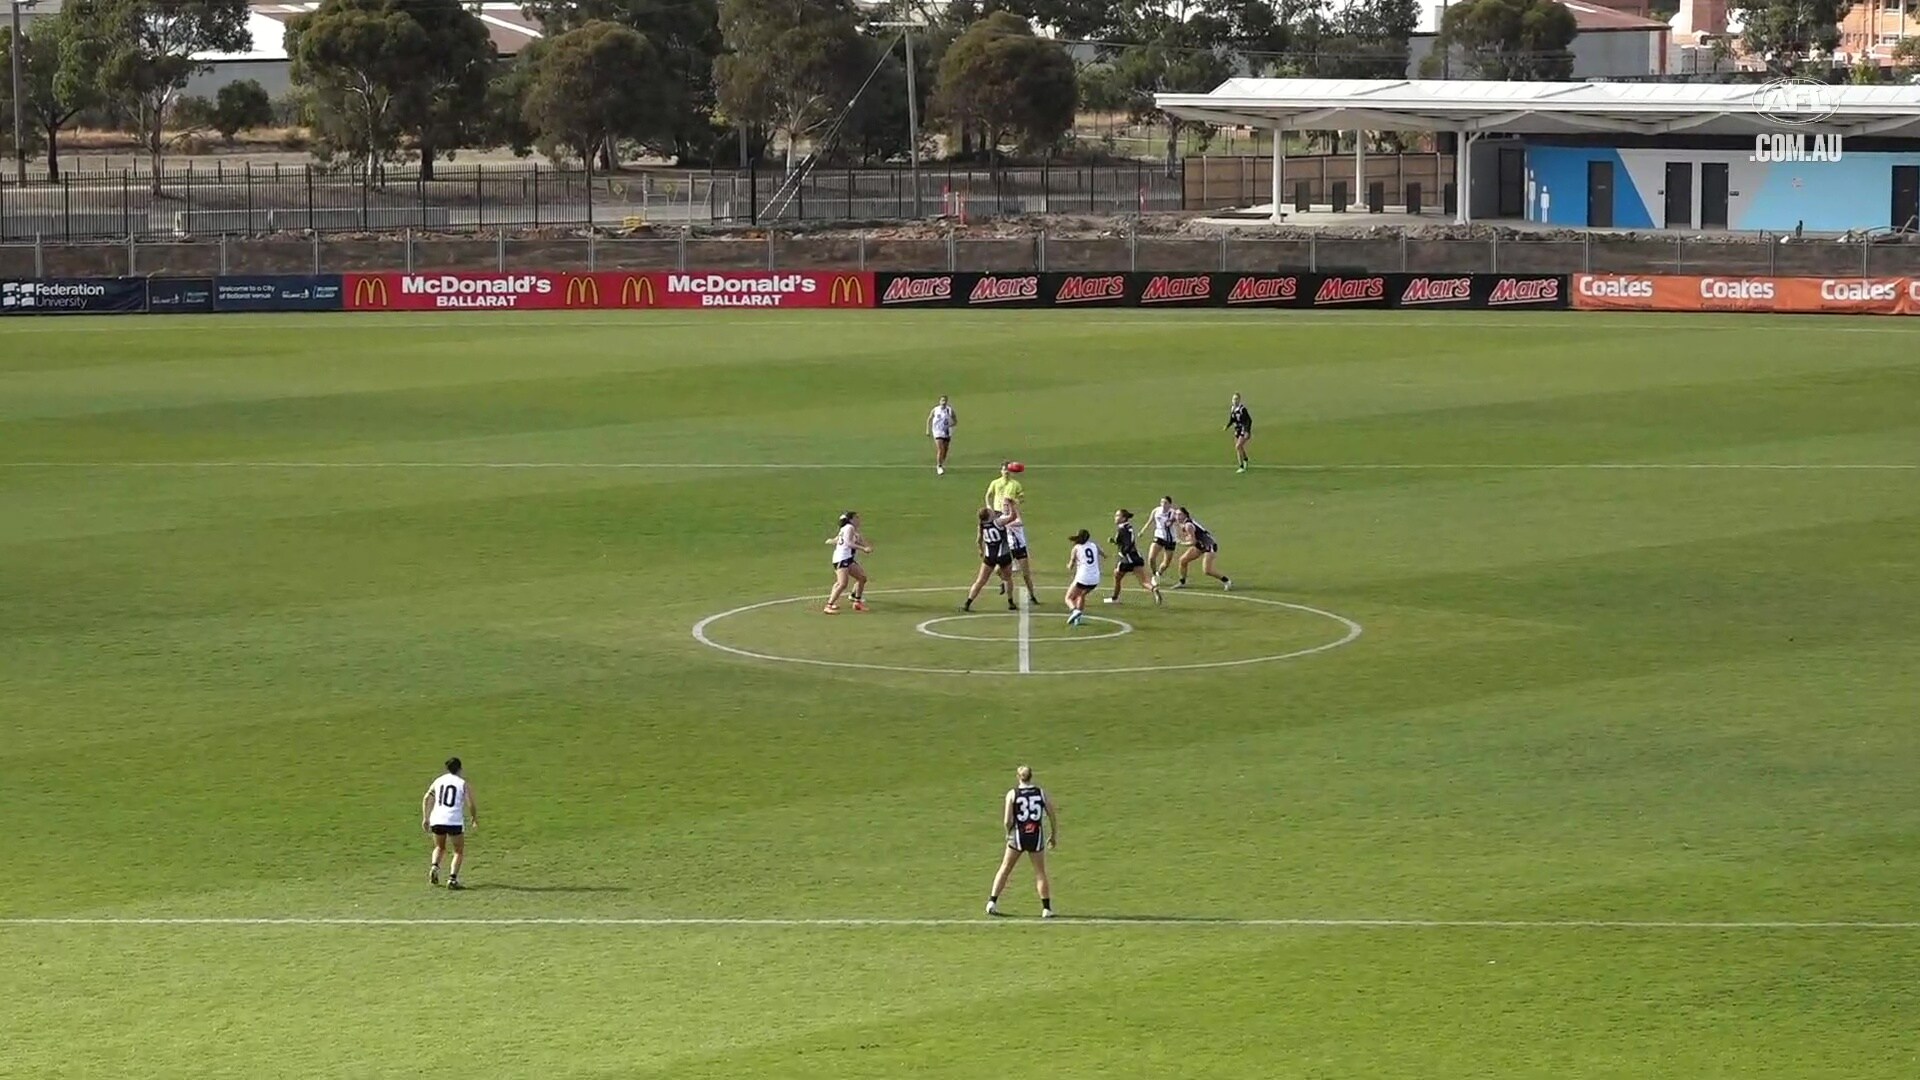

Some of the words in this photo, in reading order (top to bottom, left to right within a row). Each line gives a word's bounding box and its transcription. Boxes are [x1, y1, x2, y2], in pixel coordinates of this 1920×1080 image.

[35, 284, 104, 296] Federation
[402, 276, 551, 294] McDonald's
[668, 275, 816, 293] McDonald's
[883, 276, 951, 303] Mars
[969, 276, 1038, 303] Mars
[1056, 276, 1124, 303] Mars
[1141, 276, 1210, 302] Mars
[1228, 277, 1296, 303] Mars
[1314, 277, 1384, 304] Mars
[1401, 278, 1471, 304] Mars
[1488, 278, 1558, 305] Mars
[1579, 276, 1653, 297] Coates
[1700, 278, 1774, 299] Coates
[1821, 279, 1896, 300] Coates
[35, 297, 88, 308] University
[436, 295, 517, 307] BALLARAT
[702, 295, 782, 306] BALLARAT
[983, 527, 1001, 543] 40
[1085, 547, 1095, 564] 9
[439, 784, 457, 807] 10
[1016, 795, 1042, 822] 35
